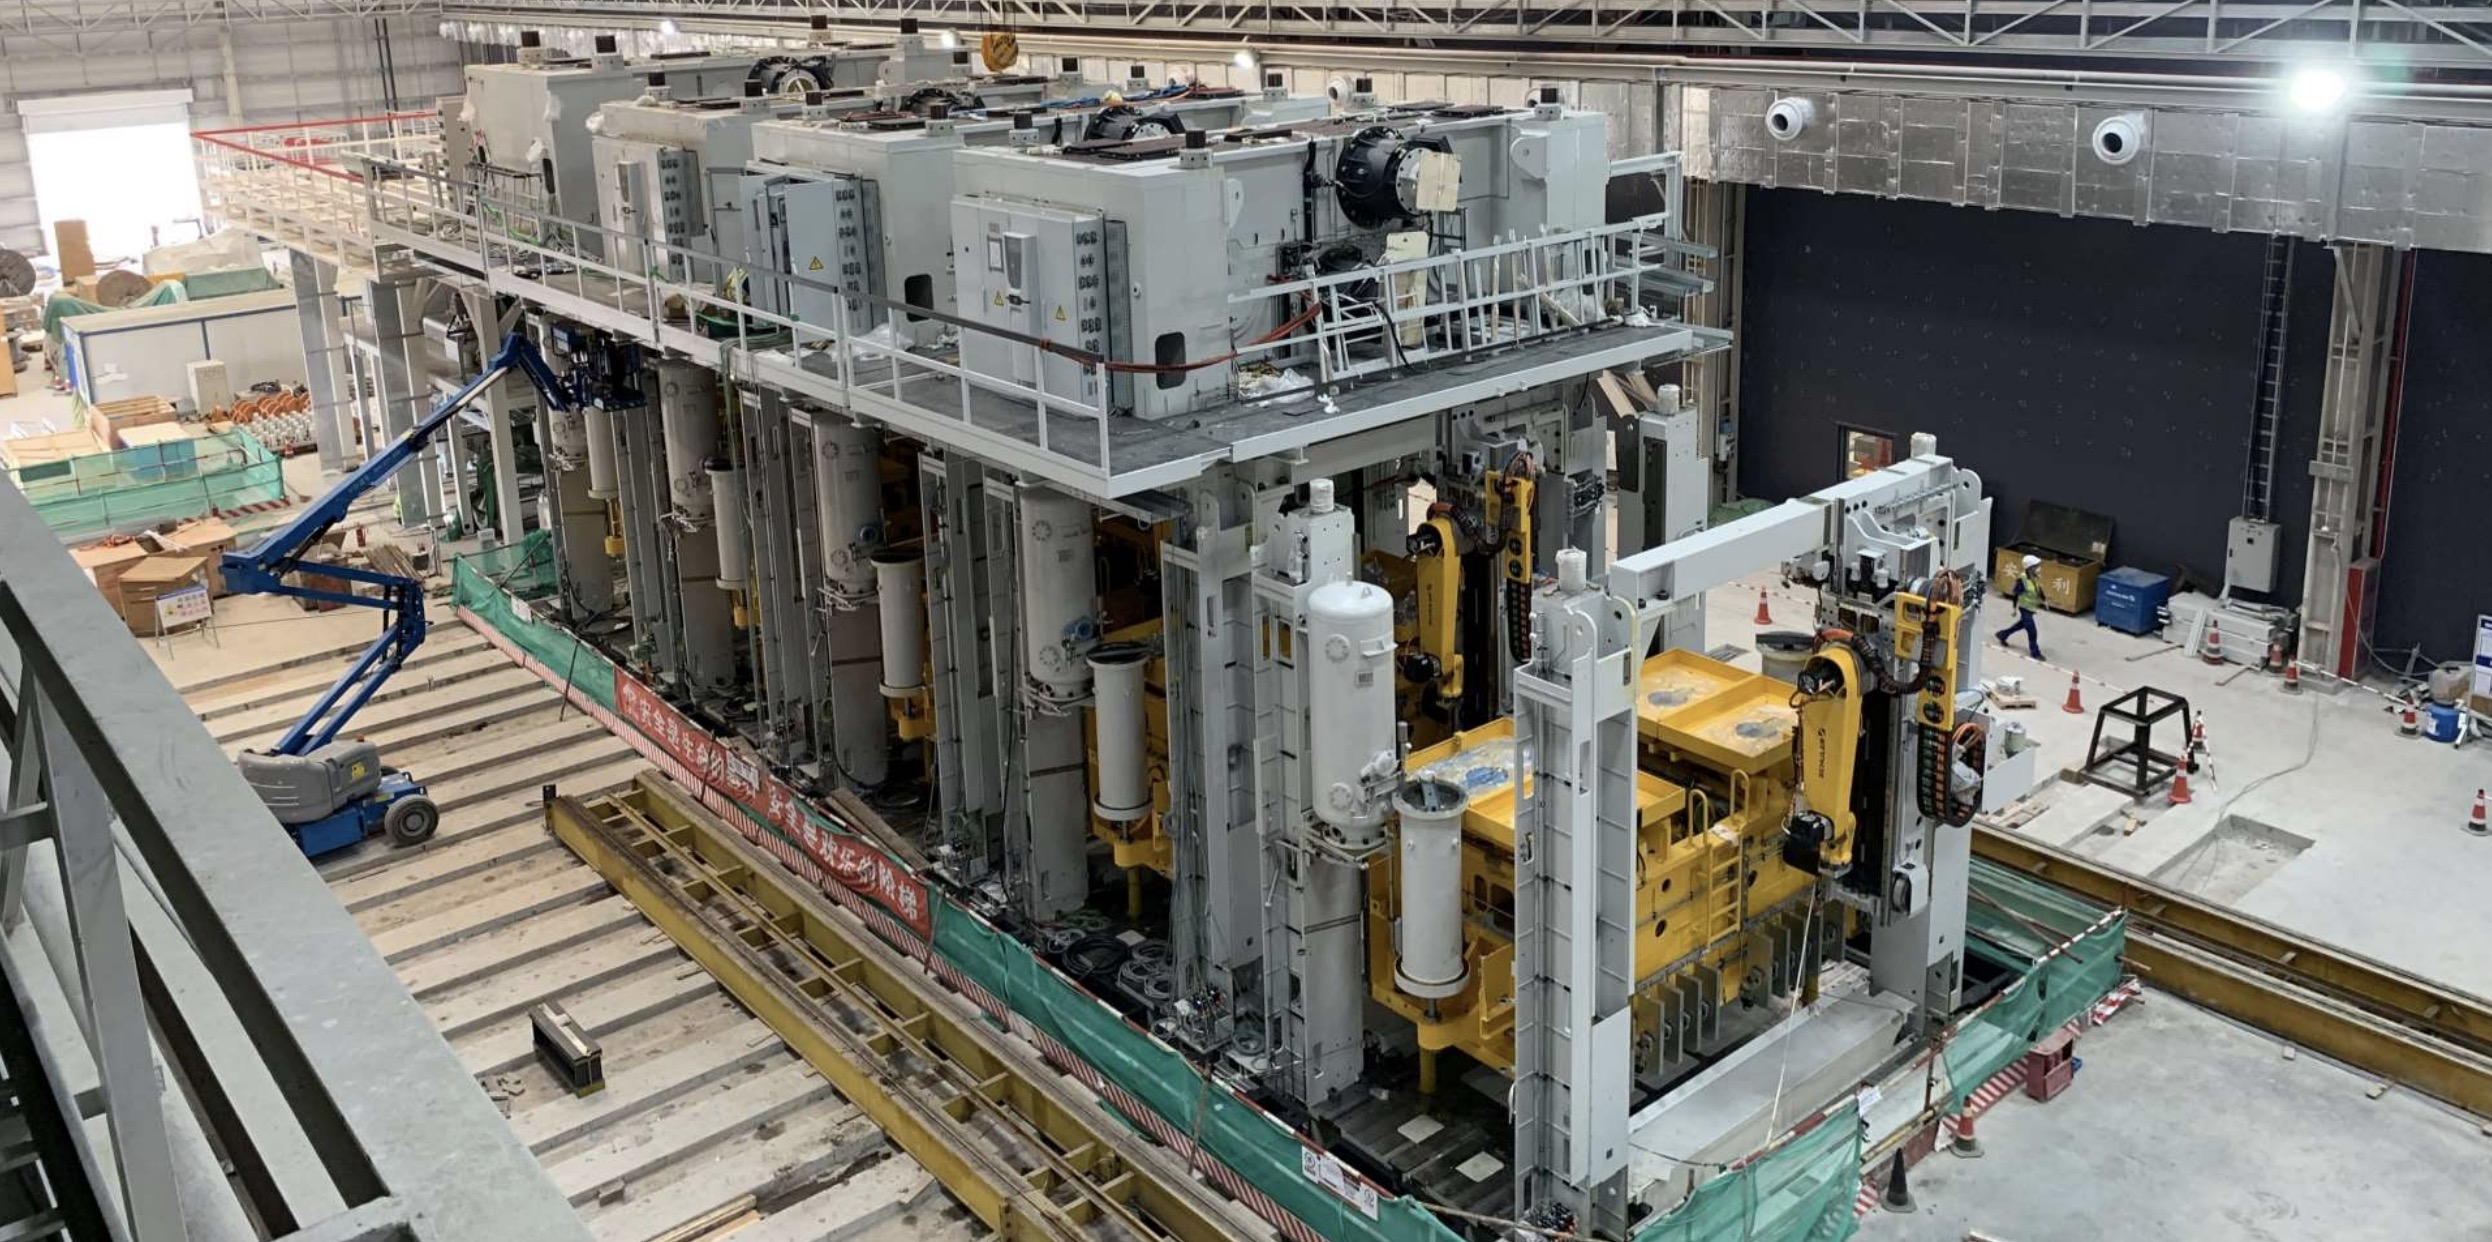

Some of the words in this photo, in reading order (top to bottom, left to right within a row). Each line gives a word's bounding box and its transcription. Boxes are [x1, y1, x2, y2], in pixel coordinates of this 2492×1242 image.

[639, 698, 759, 799] 安全是生命的
